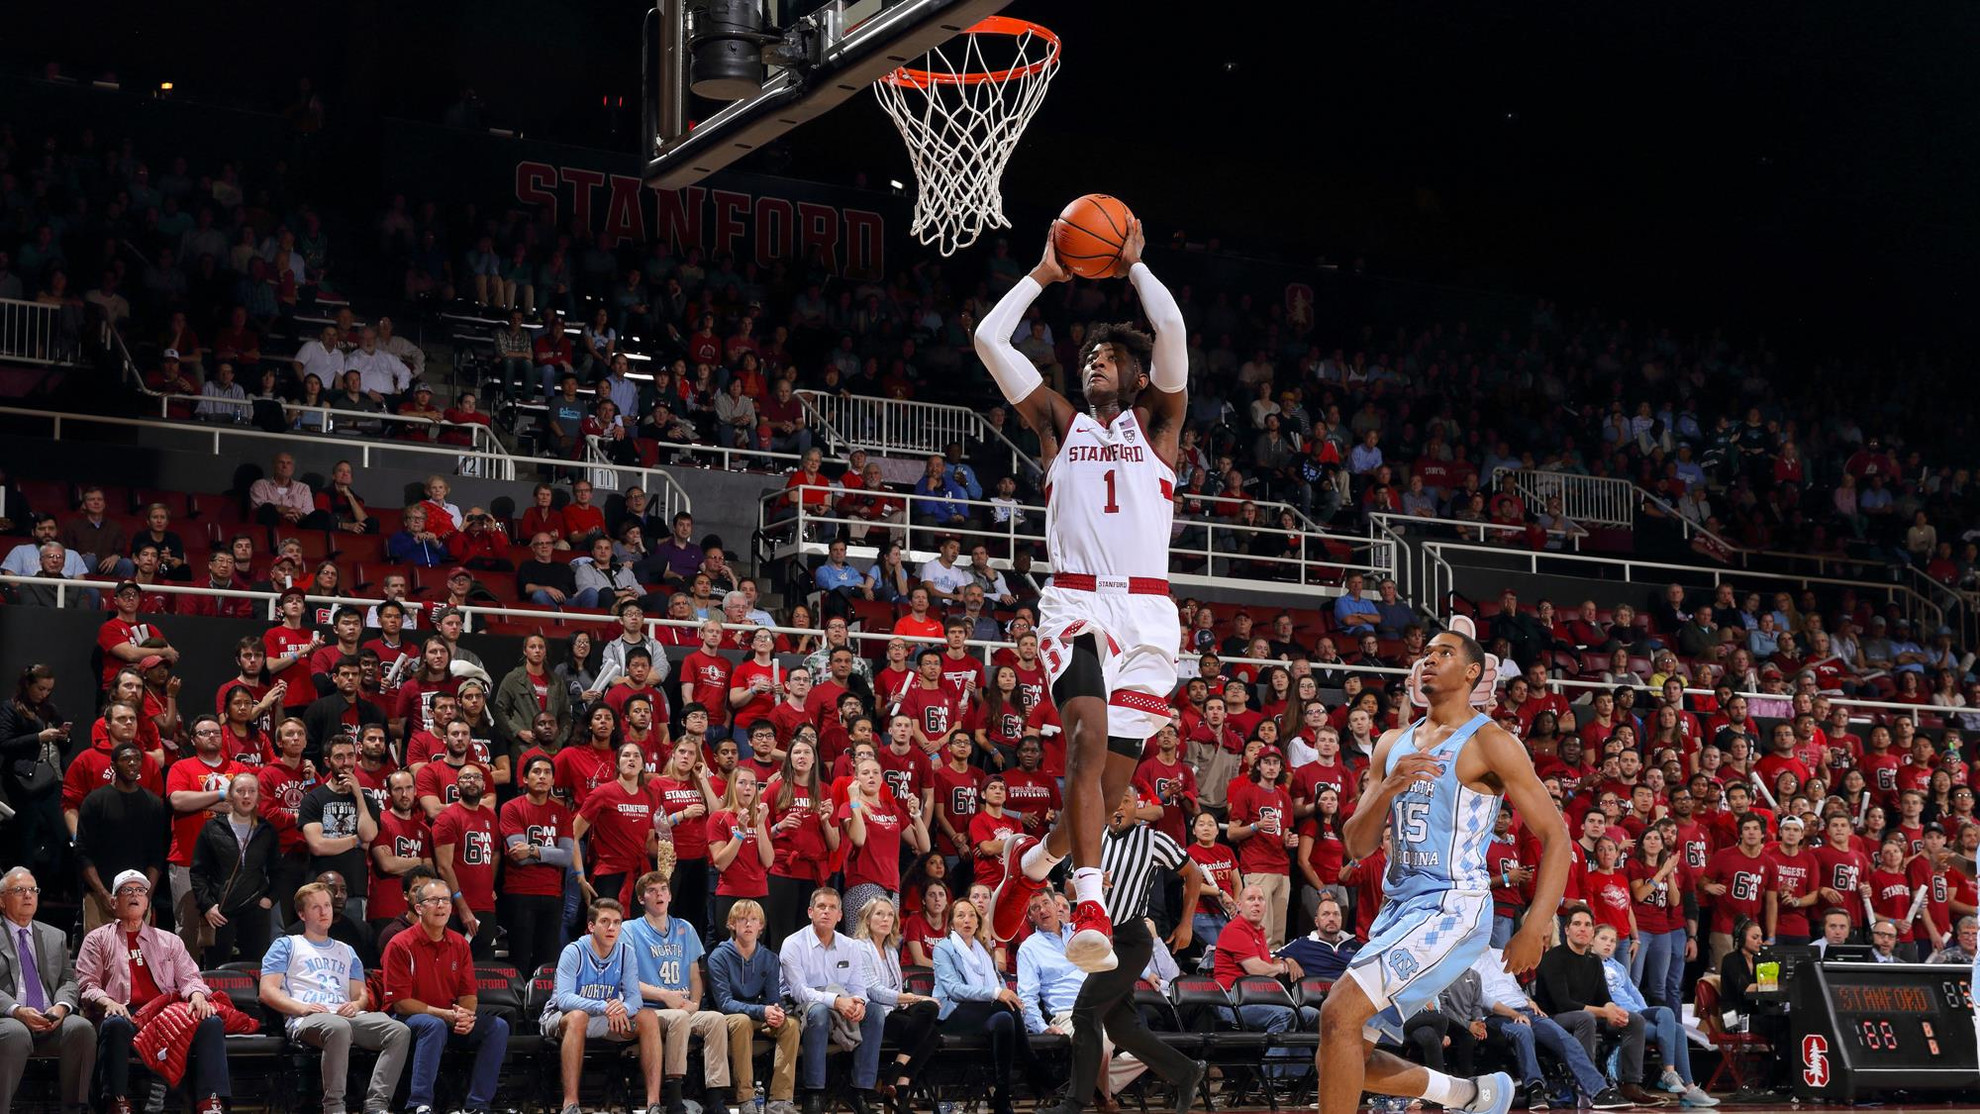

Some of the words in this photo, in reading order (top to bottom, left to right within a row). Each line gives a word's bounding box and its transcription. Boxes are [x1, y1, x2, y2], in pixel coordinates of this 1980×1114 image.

[515, 160, 885, 282] STANFORD
[1103, 469, 1119, 513] 1
[1098, 580, 1127, 589] STANFORD
[925, 706, 940, 733] 6
[953, 786, 968, 815] 6
[1410, 779, 1436, 798] RTH
[617, 803, 649, 814] STANFORD
[1396, 800, 1431, 844] 15
[464, 831, 484, 865] 6
[1685, 840, 1700, 867] 6
[1732, 871, 1750, 900] 6
[1833, 864, 1850, 890] 6
[1932, 875, 1948, 903] 6
[650, 944, 682, 958] NORTH
[304, 957, 346, 974] NORTH
[658, 961, 680, 984] 40
[579, 984, 615, 999] NORTH
[1838, 986, 1929, 1011] STANFORD
